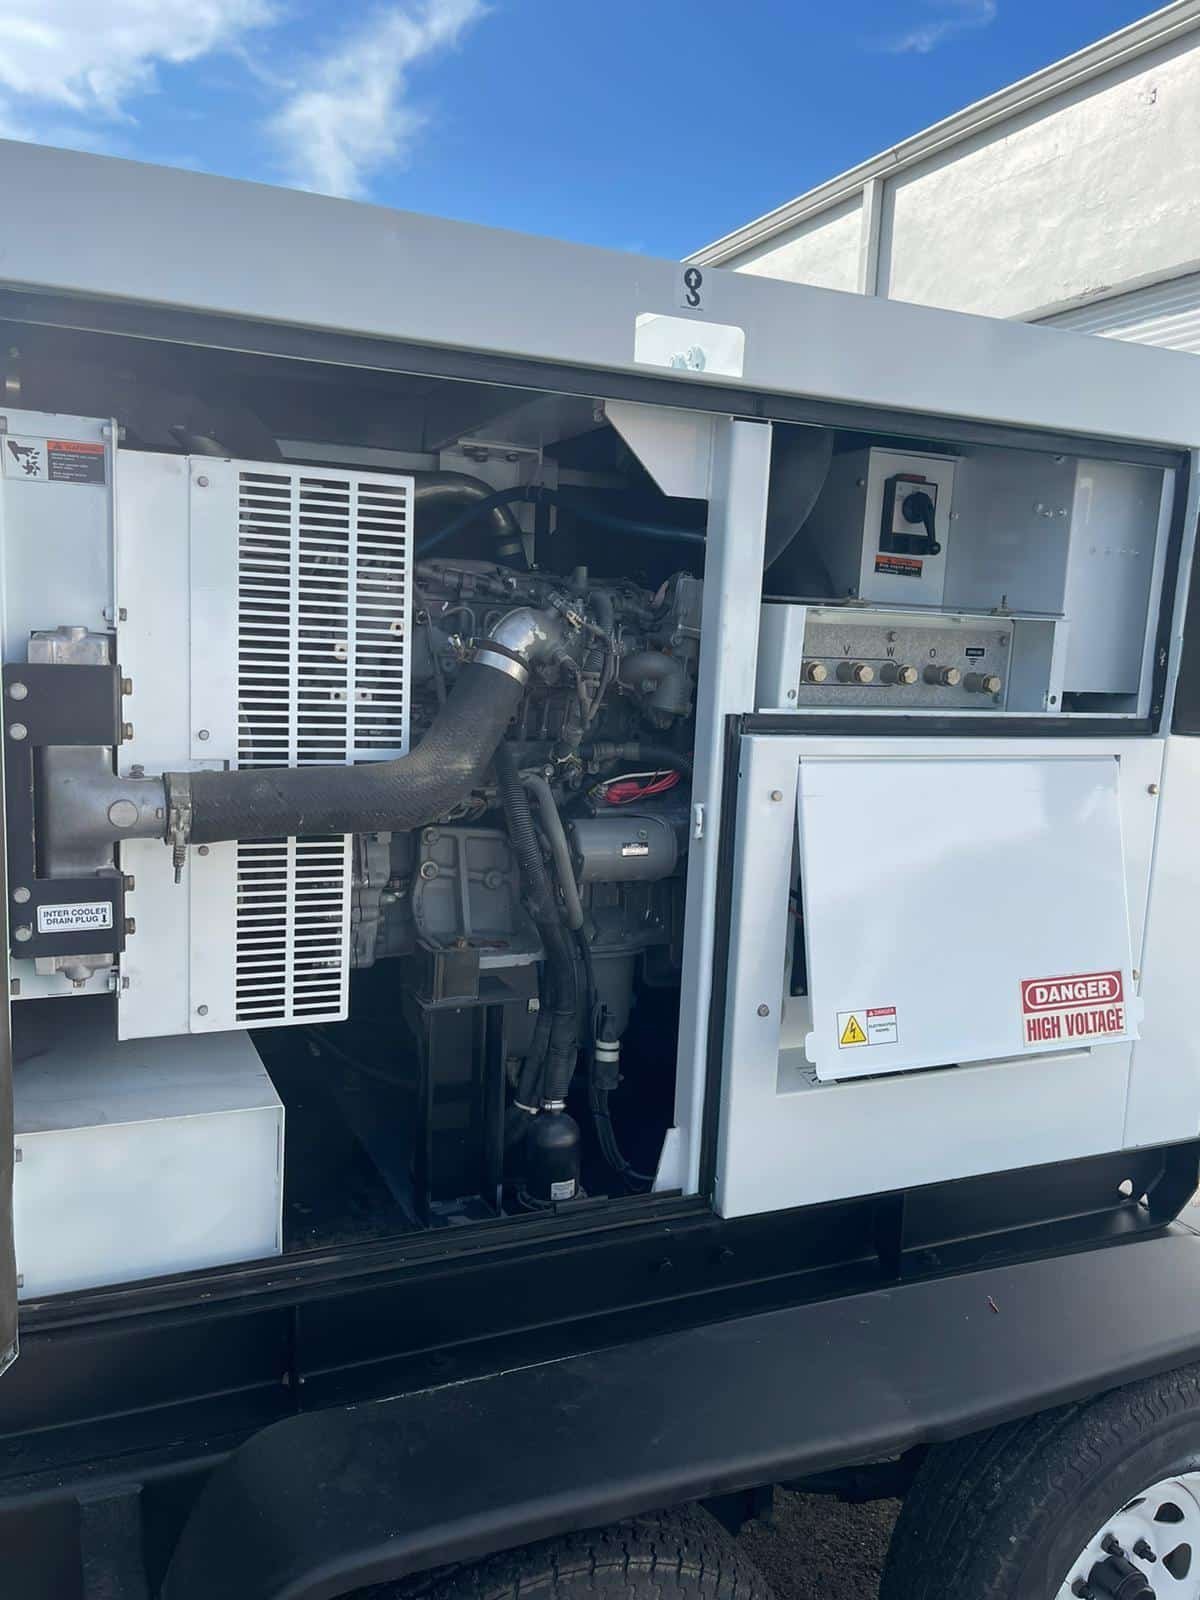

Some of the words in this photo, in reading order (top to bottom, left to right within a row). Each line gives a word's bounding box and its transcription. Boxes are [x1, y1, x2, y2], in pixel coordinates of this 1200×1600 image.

[843, 645, 851, 656] V
[886, 647, 896, 657] W
[43, 910, 69, 918] INTER
[71, 908, 107, 916] COOLER
[46, 917, 73, 925] DRAIN
[75, 915, 99, 924] PLUG
[1035, 980, 1111, 1003] DANGER
[1026, 1015, 1062, 1042] HIGH
[1064, 1007, 1124, 1036] VOLTAGE
